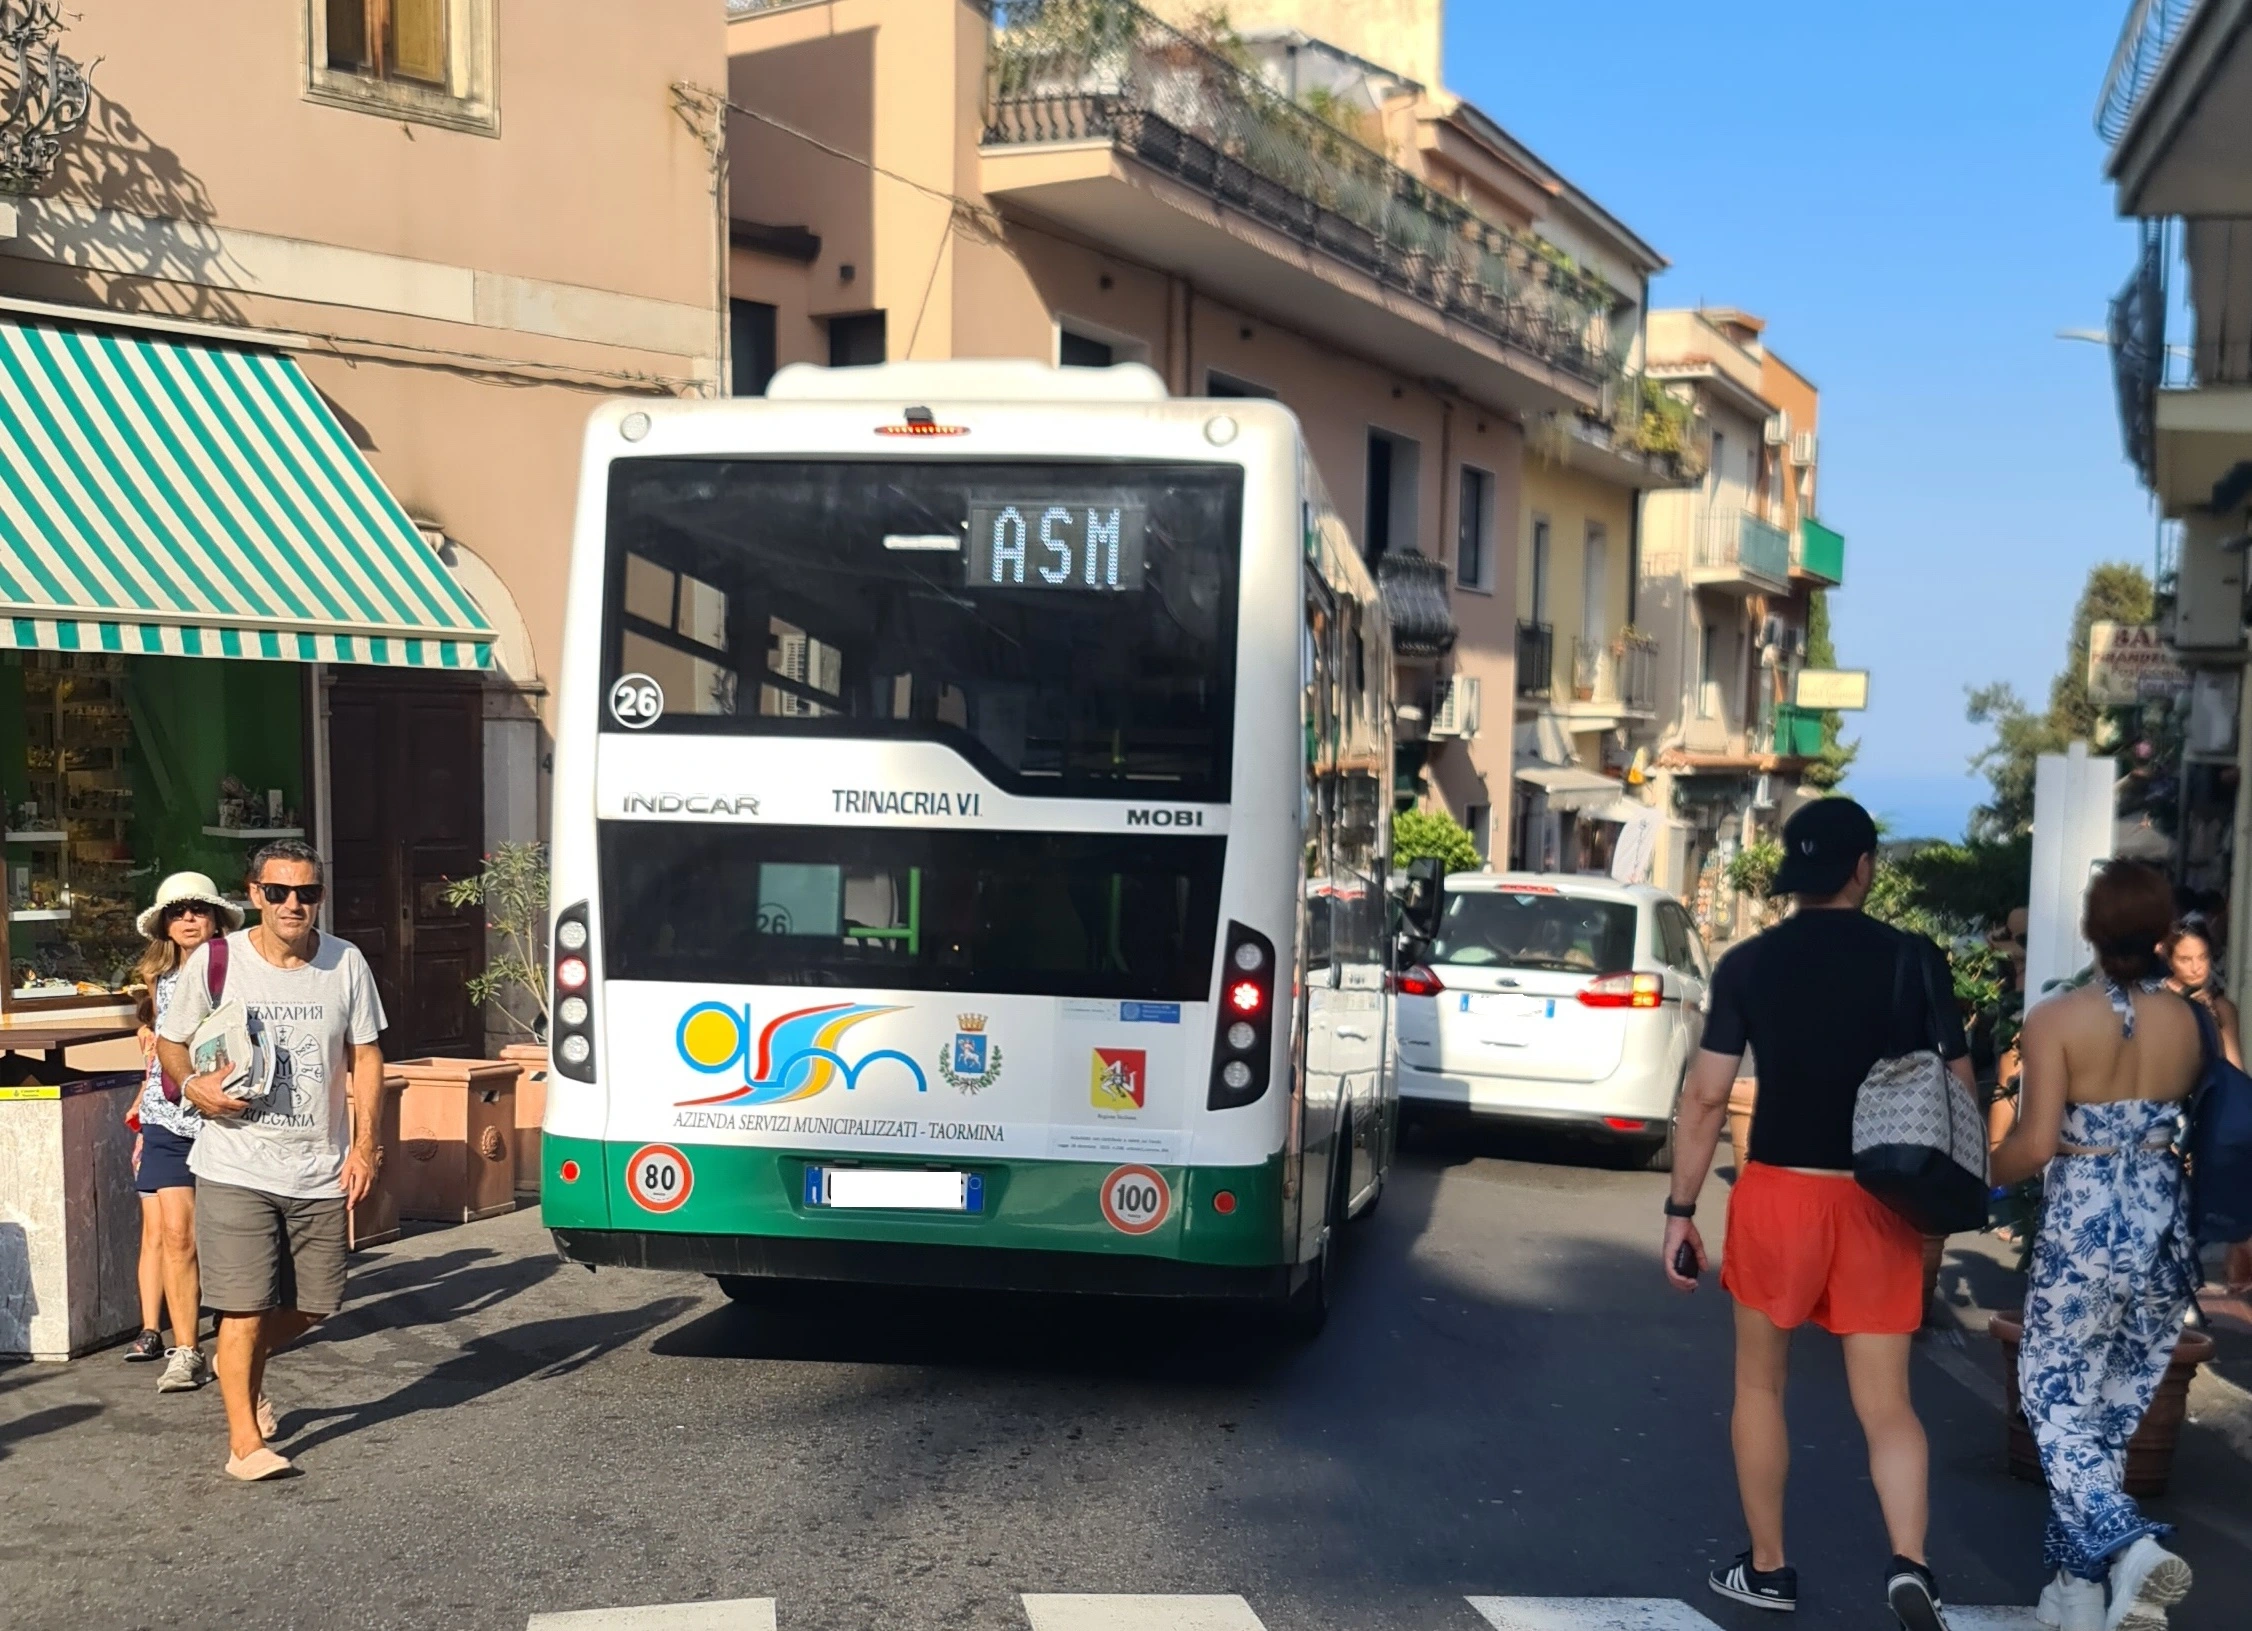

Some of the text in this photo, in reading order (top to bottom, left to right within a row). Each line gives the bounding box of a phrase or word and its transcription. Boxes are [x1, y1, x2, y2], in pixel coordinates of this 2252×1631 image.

[992, 506, 1120, 585] ASM
[616, 685, 657, 717] 26
[623, 792, 760, 816] INDCAR
[832, 789, 952, 816] TRINACRIA
[1127, 809, 1203, 827] MOBI
[673, 1112, 735, 1130] AZIENDA
[739, 1114, 792, 1132] SERVIZI
[794, 1117, 918, 1139] MUNICIPALIZZATI
[929, 1122, 1005, 1142] TAORMINA
[645, 1164, 676, 1191] 80
[1117, 1184, 1158, 1213] 100
